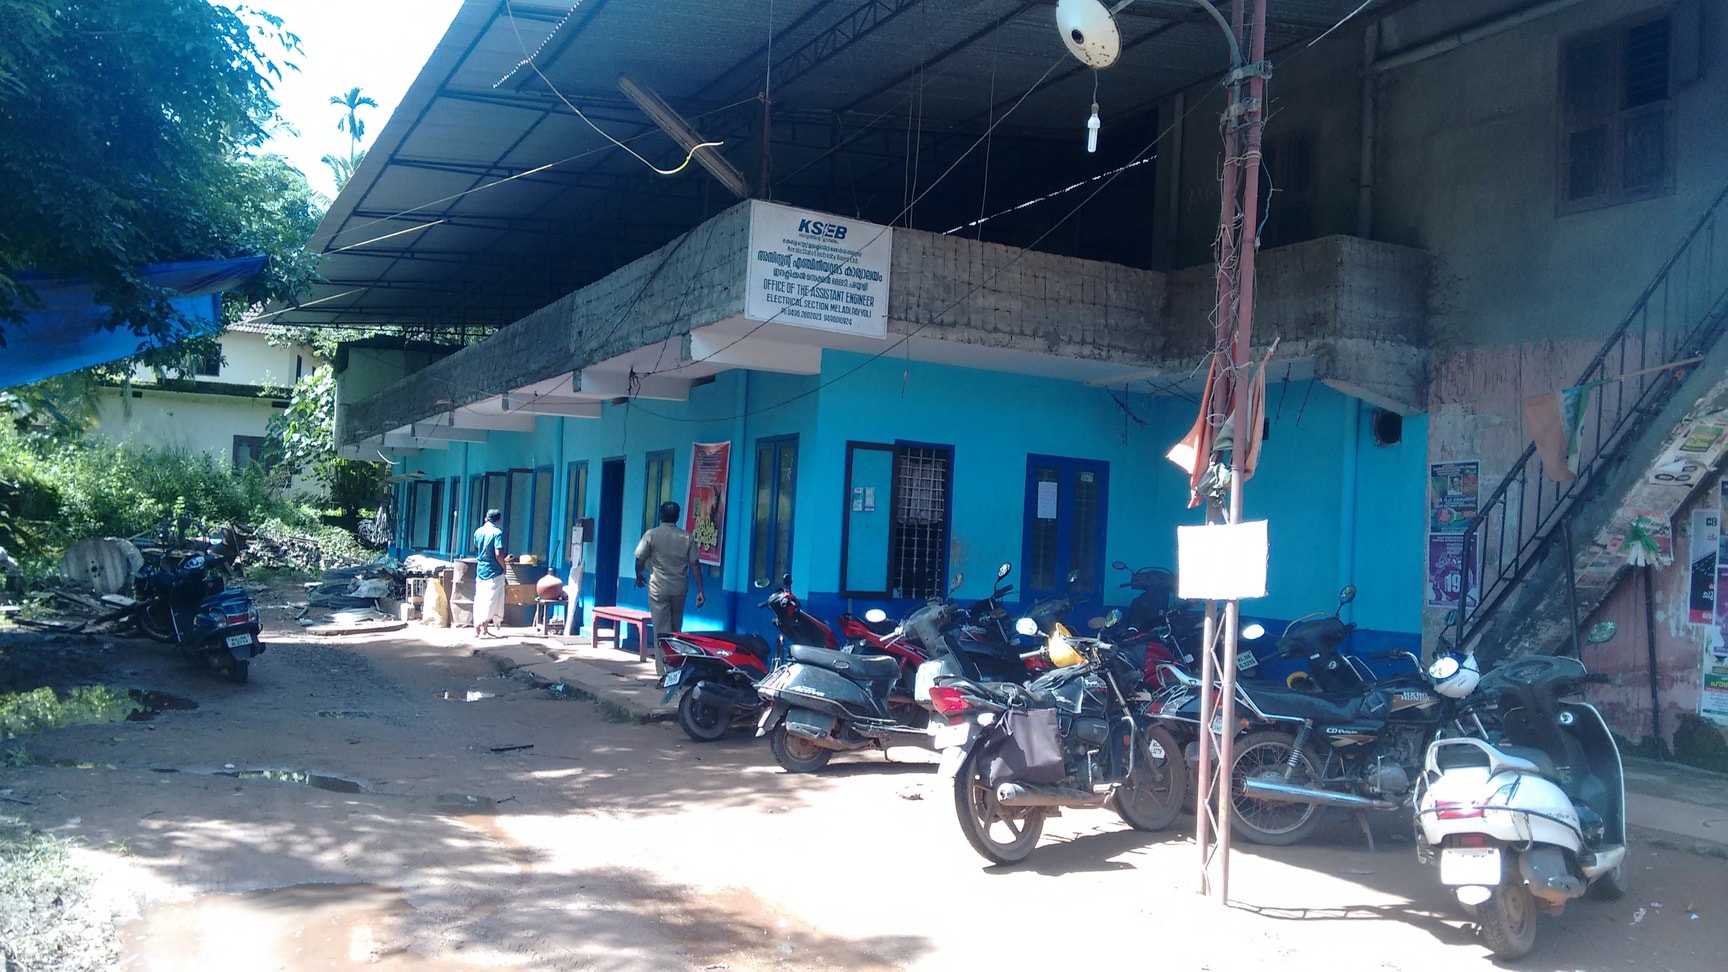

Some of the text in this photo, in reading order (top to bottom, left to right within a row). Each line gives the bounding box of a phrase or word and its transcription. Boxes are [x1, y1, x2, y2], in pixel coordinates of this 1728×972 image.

[798, 219, 847, 240] KSEB
[763, 279, 874, 307] OFFICE OF THE ASSISTANT ENGINEER
[766, 294, 802, 307] ELECTRICAL
[804, 300, 829, 311] SECTION
